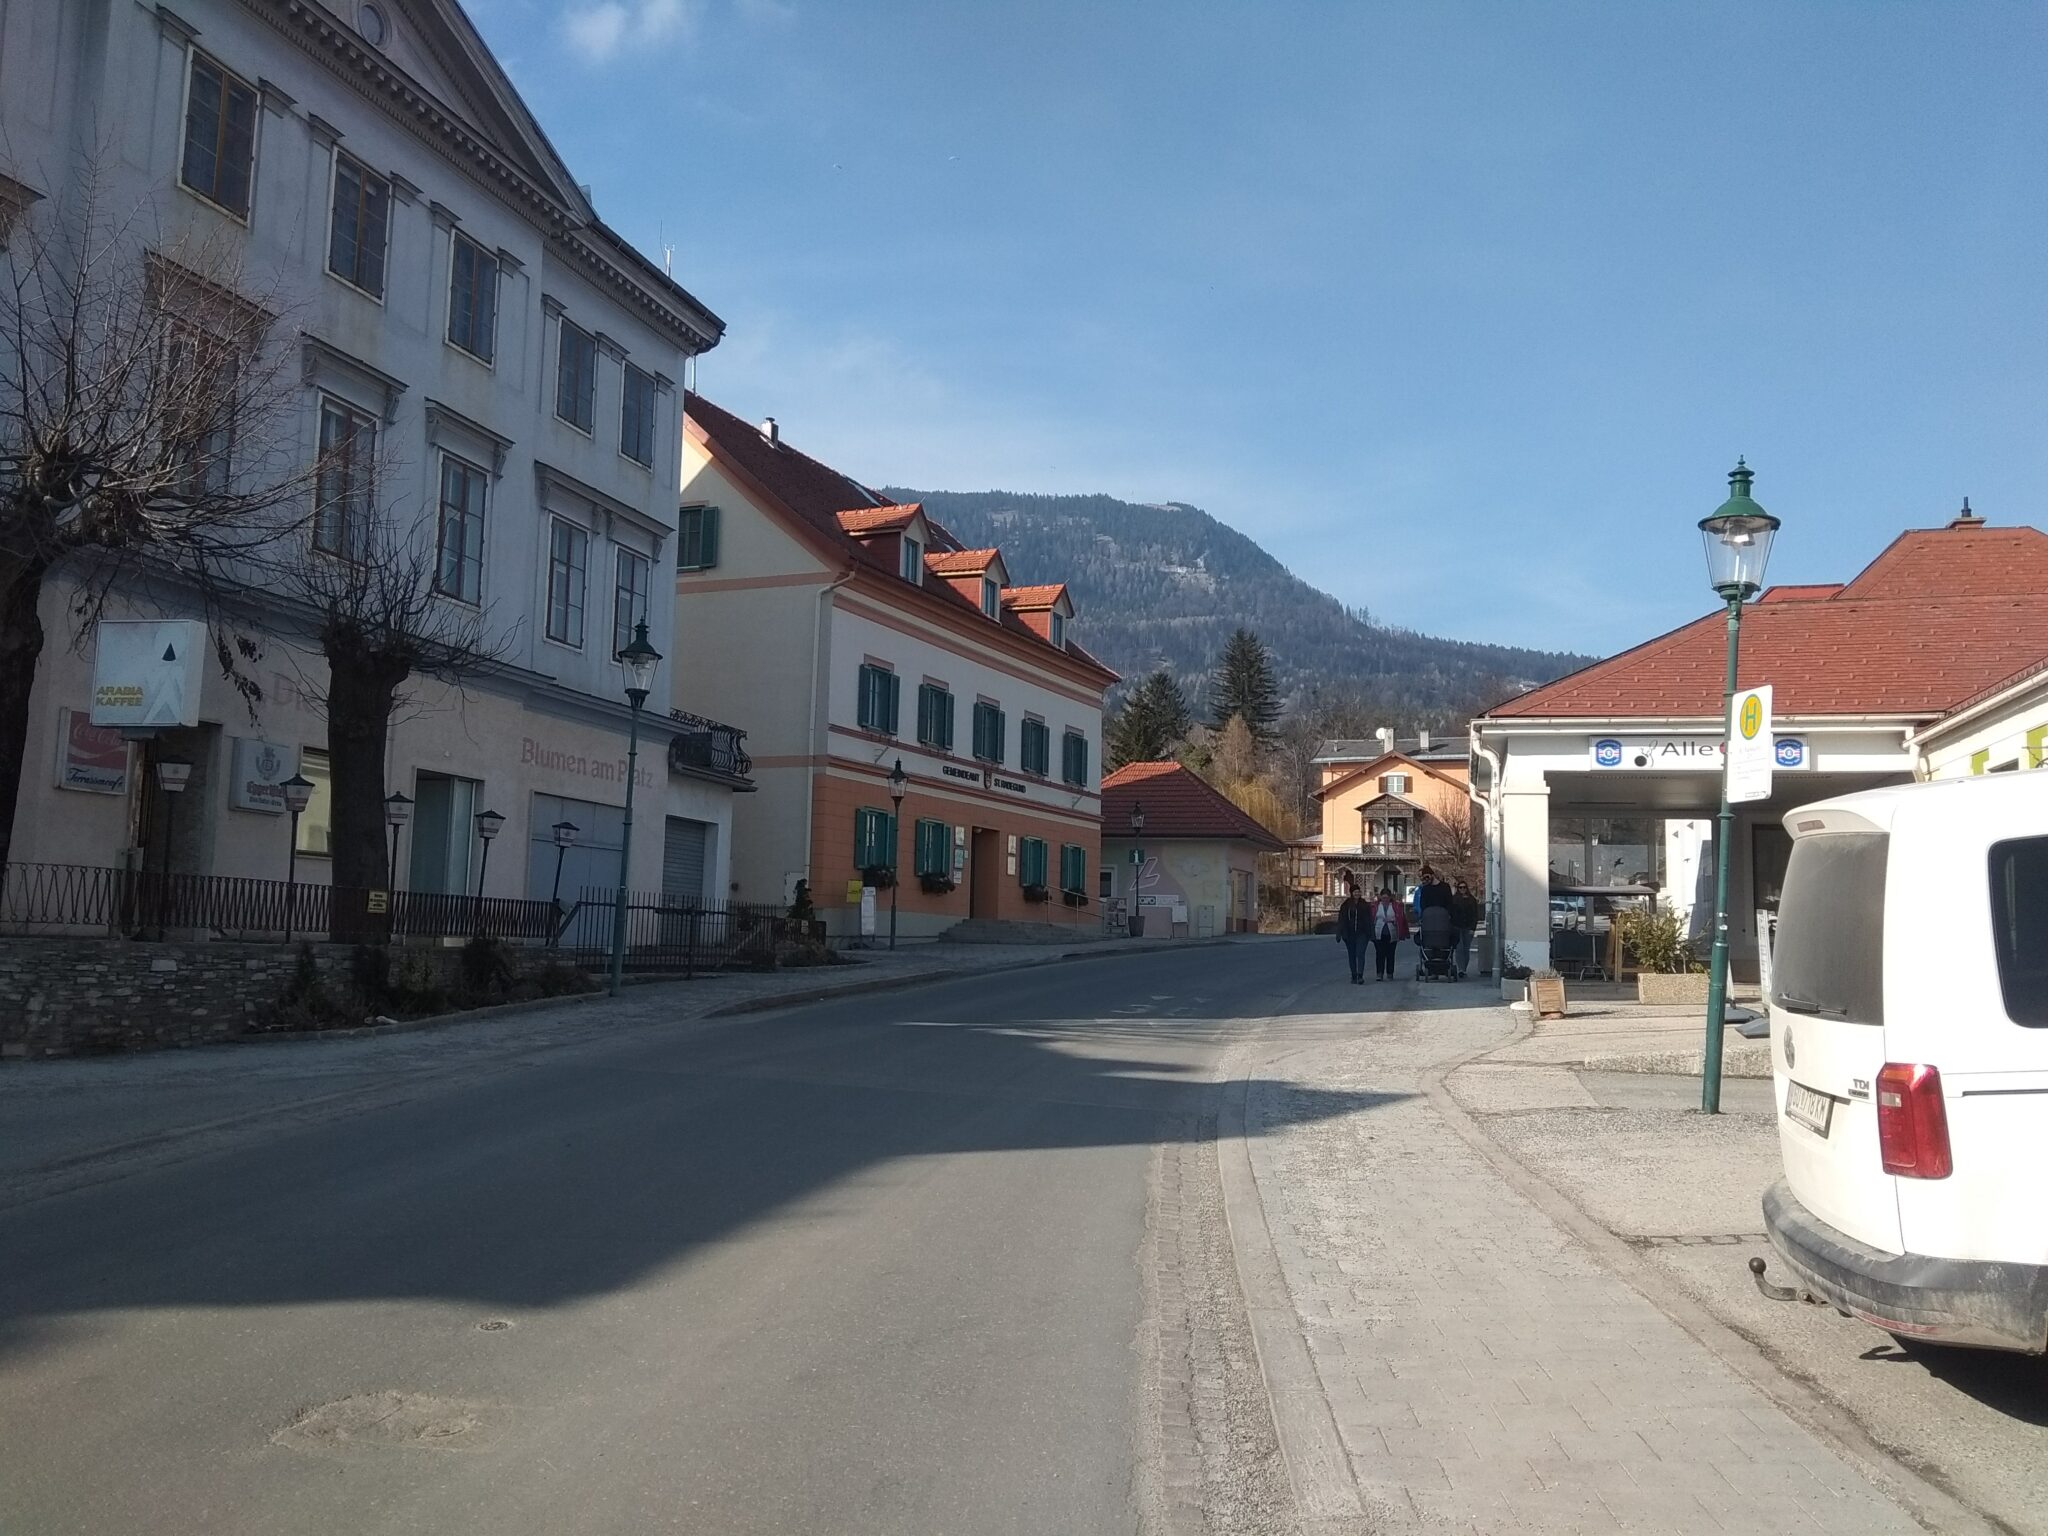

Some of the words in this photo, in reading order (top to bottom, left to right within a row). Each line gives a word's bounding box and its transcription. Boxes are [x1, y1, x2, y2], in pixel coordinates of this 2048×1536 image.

[96, 686, 144, 696] ARABIA
[95, 697, 143, 707] KAFFEE
[1745, 702, 1757, 731] H
[1661, 741, 1714, 756] Alle
[520, 736, 587, 776] Blumen
[591, 759, 615, 781] am
[617, 758, 654, 789] Patz
[942, 765, 980, 783] GEMEINDEAMT
[1852, 1078, 1870, 1091] TDI
